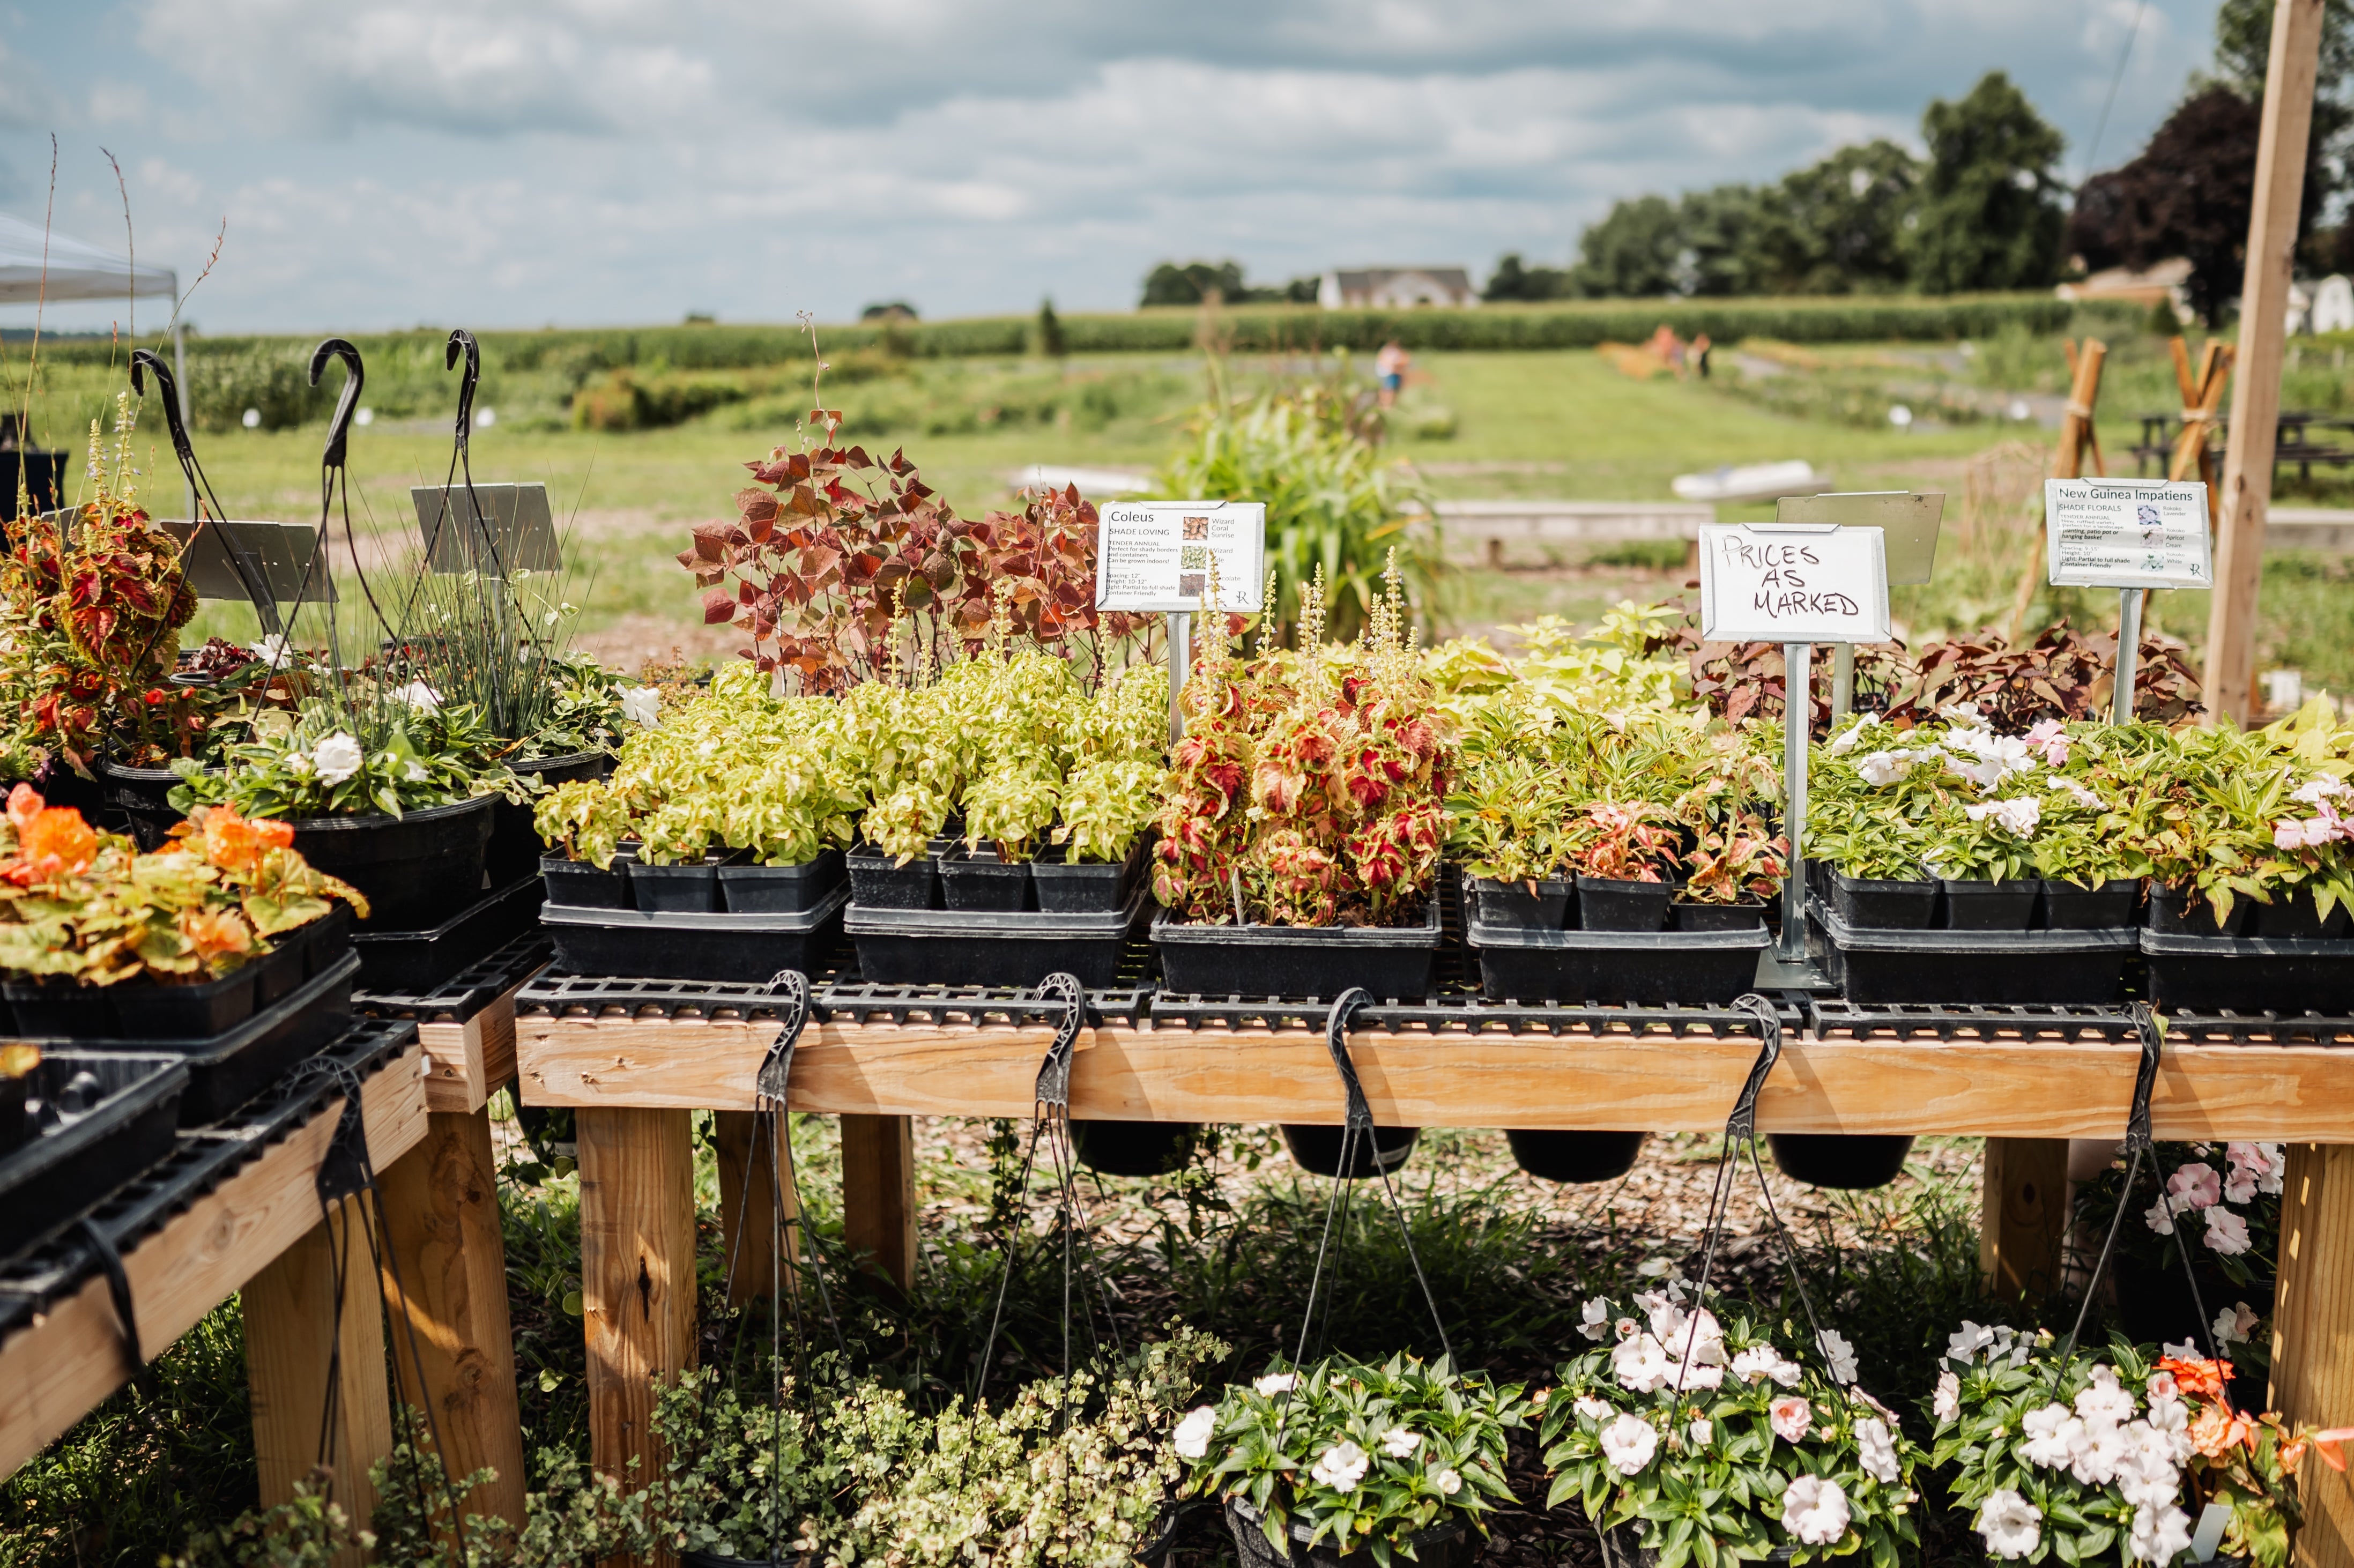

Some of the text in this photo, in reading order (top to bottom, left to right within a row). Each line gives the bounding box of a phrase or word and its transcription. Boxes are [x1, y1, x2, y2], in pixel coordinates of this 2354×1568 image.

[2060, 488, 2193, 502] New Guinea Impatiens
[1111, 511, 1154, 522] Coleus
[1722, 535, 1820, 569] PRICES
[1762, 568, 1805, 589] AS
[1755, 589, 1859, 619] MARKED
